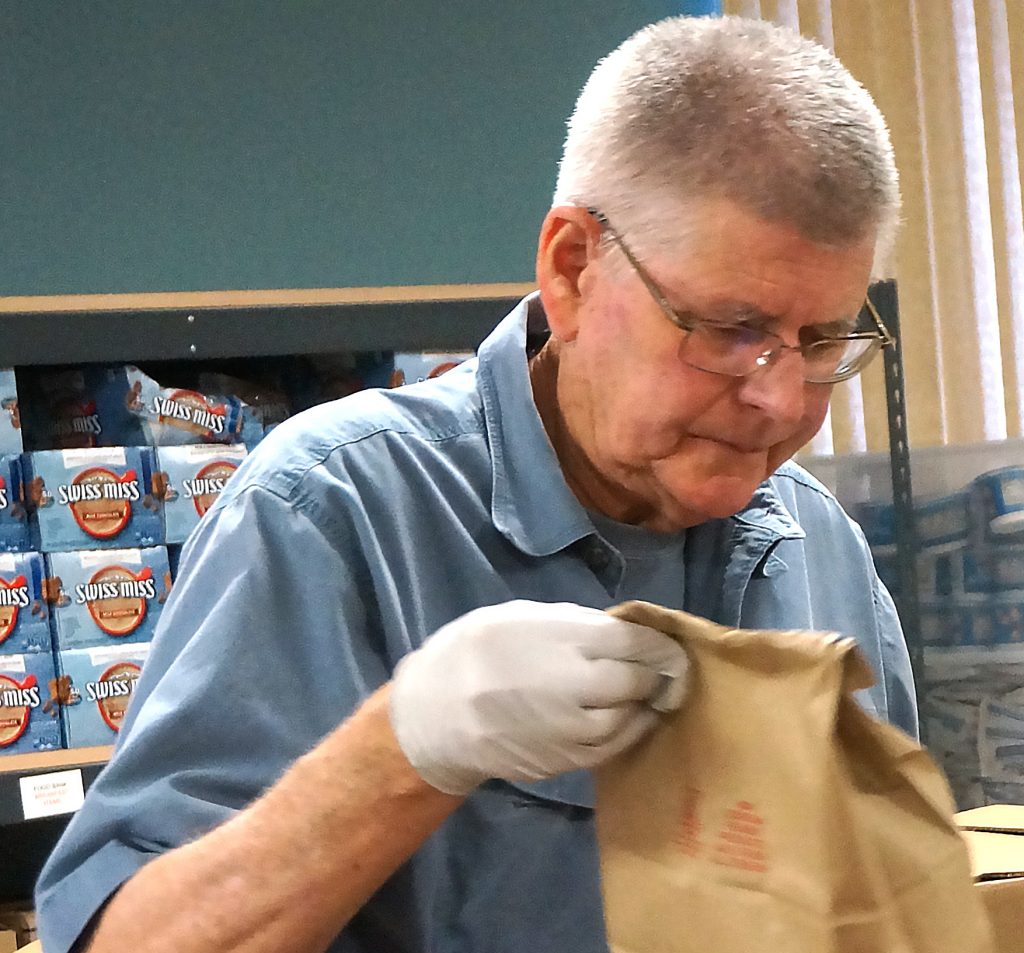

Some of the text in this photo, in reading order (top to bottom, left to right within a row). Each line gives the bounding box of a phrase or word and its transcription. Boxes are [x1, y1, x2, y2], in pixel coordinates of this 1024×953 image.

[149, 396, 226, 434] SWISS MISS
[58, 479, 140, 505] SWISS MISS
[182, 478, 225, 498] SWISS
[75, 578, 156, 604] SWISS MISS
[3, 686, 40, 708] MISS
[86, 680, 130, 702] SWISS
